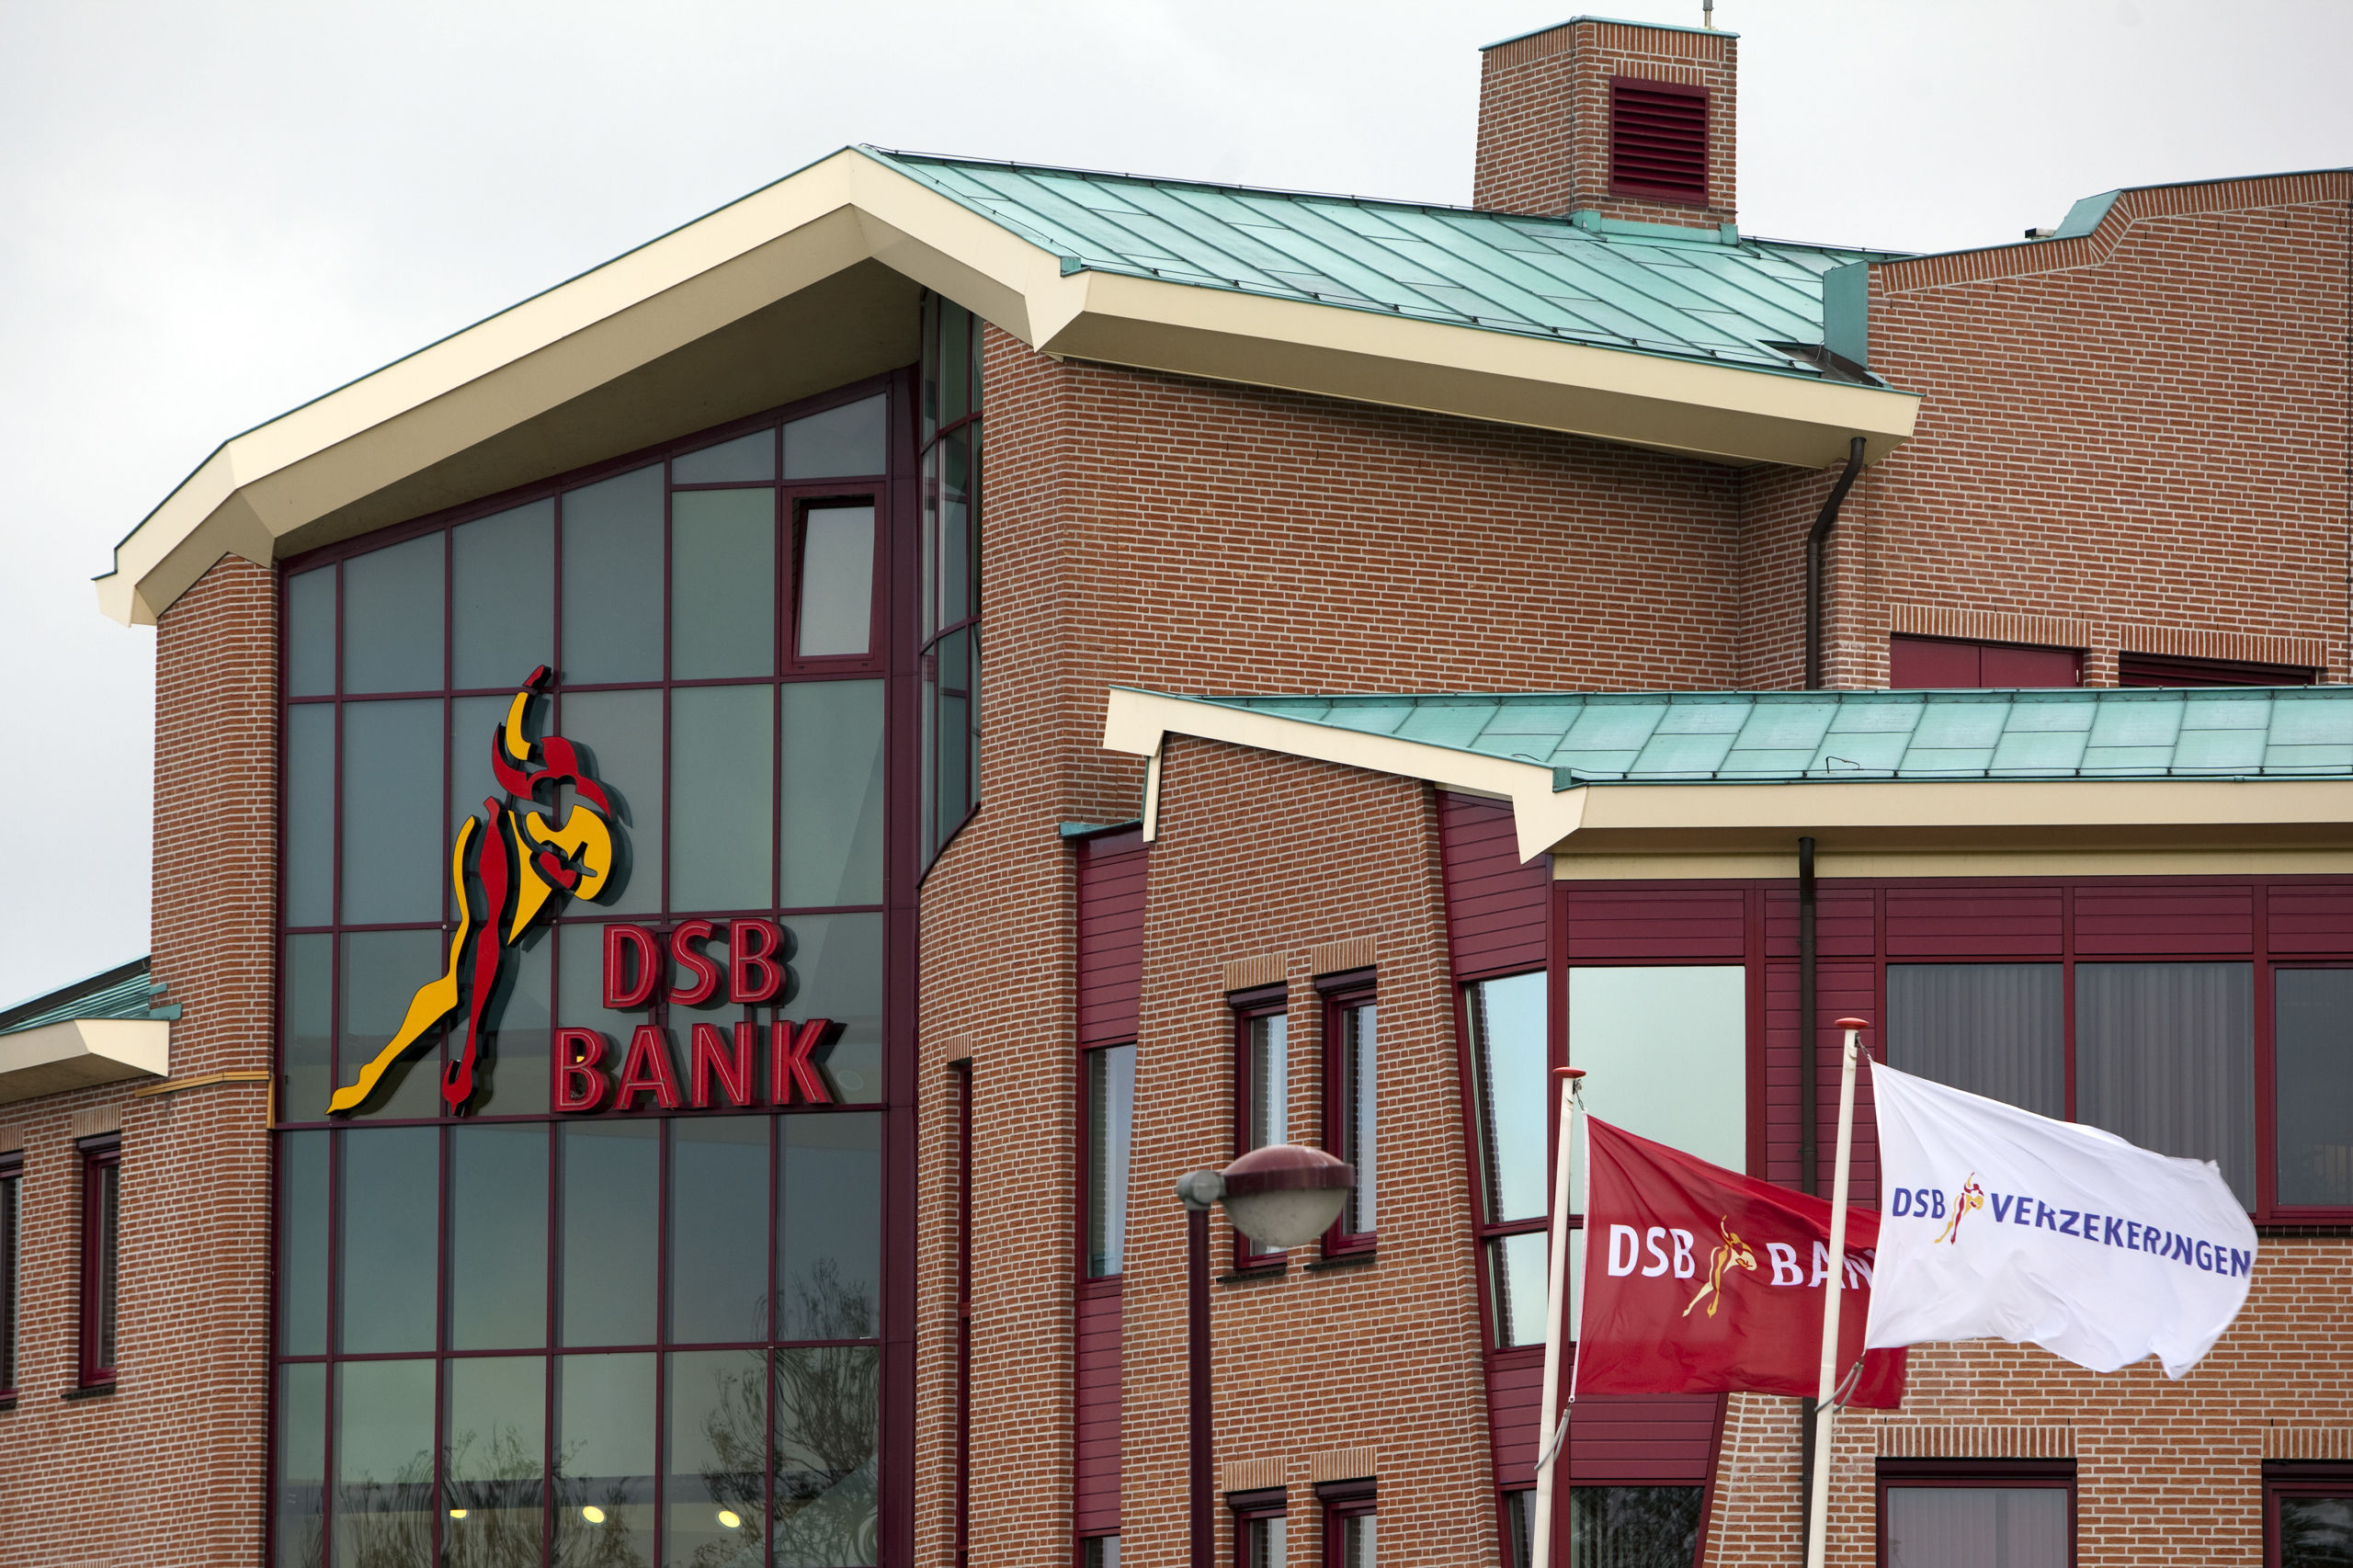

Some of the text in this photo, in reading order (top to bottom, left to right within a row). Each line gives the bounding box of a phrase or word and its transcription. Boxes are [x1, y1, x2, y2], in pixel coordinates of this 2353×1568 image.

[603, 919, 785, 1009] DSB
[554, 1018, 833, 1112] BANK
[1608, 1223, 1876, 1290] DSB BAN
[1892, 1187, 2251, 1279] DSB VERZEKERINGEN
